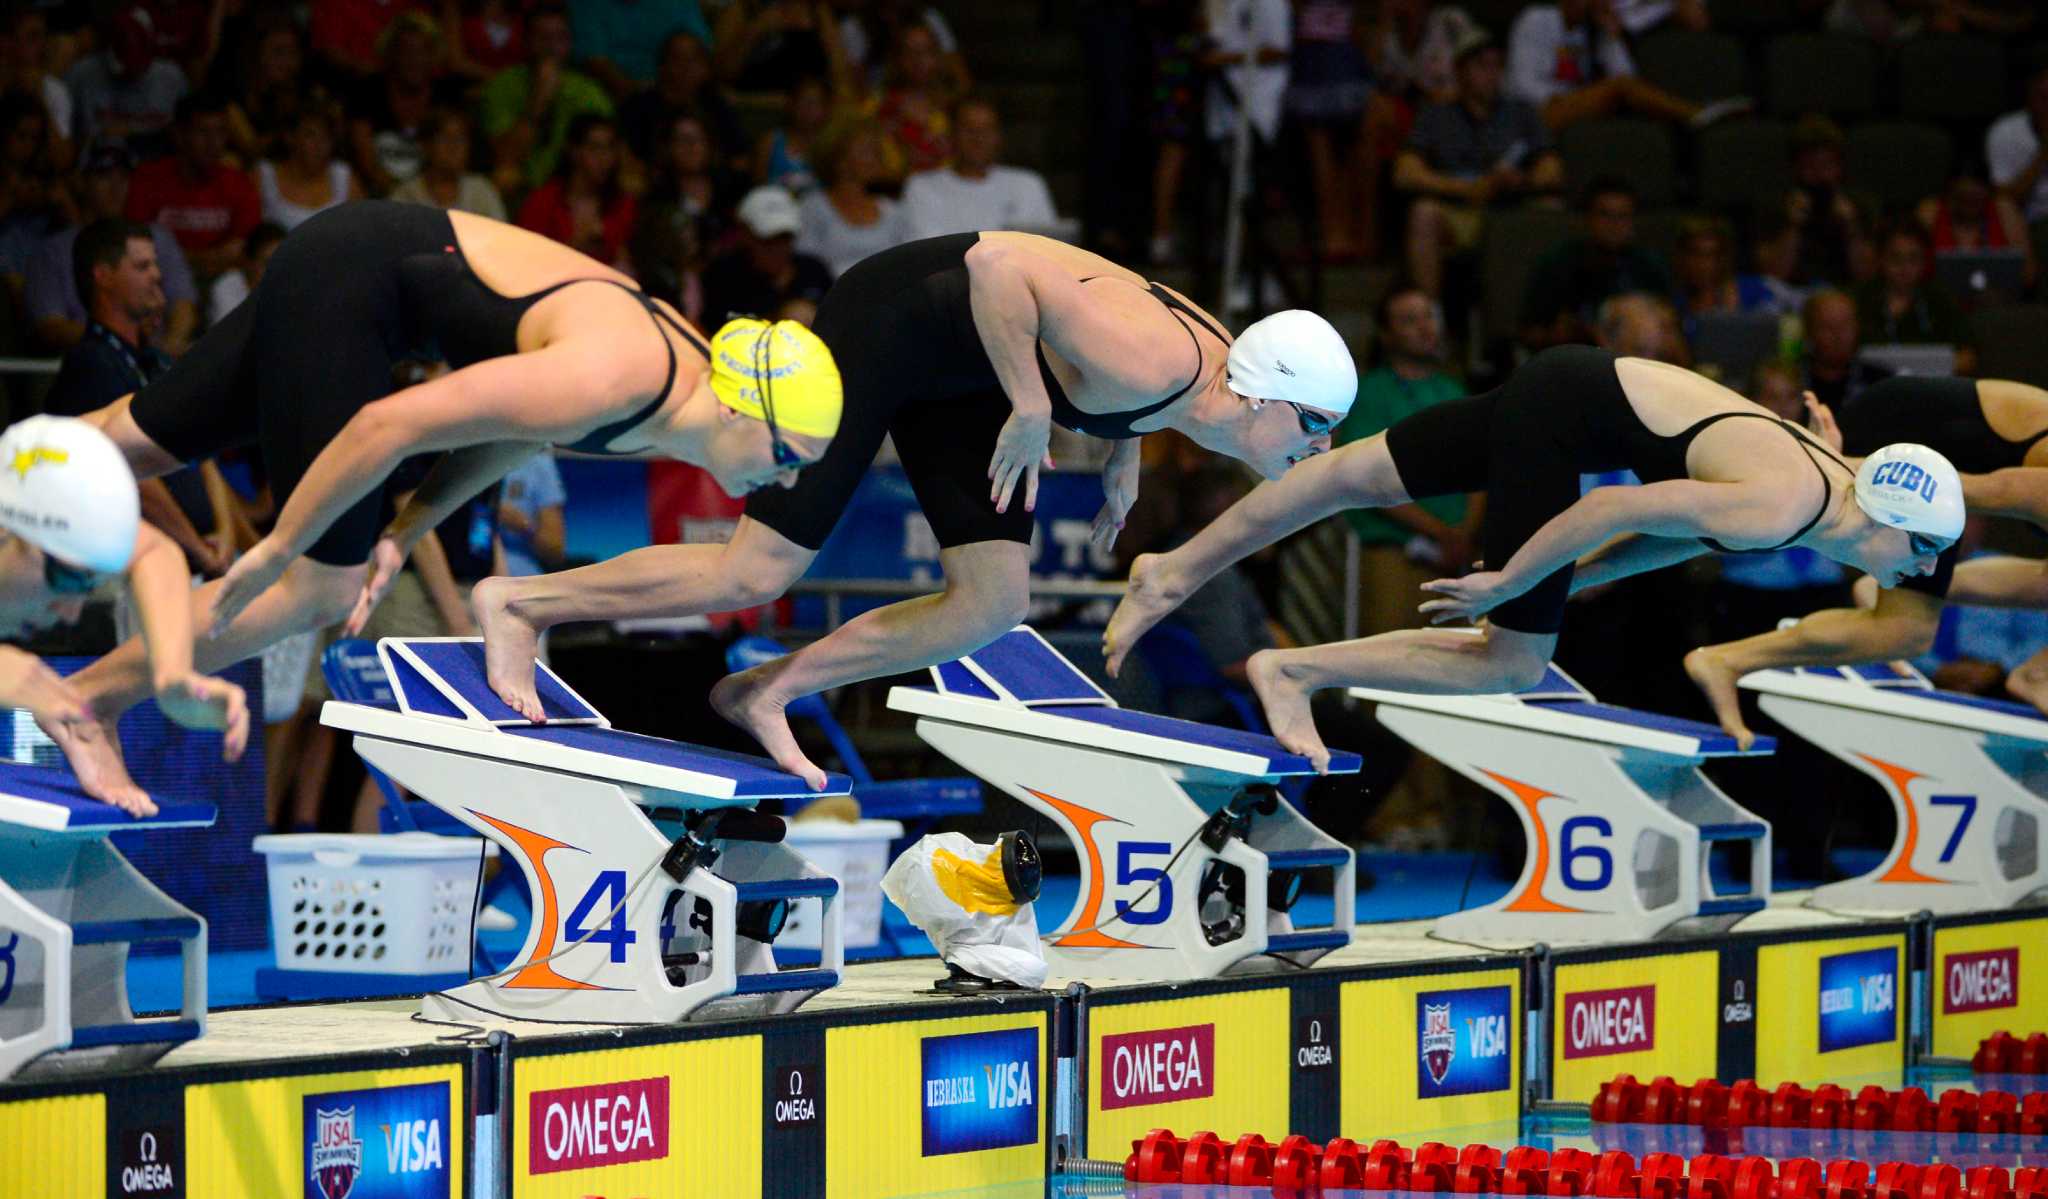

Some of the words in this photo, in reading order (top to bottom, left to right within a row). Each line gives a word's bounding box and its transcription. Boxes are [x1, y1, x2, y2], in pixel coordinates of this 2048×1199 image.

[1871, 461, 1938, 503] CUBU
[1559, 815, 1613, 891] 6
[1929, 794, 1977, 862] 7
[1114, 841, 1173, 925] 5
[564, 870, 636, 963] 4
[1859, 973, 1894, 1016] VISA
[1949, 958, 2012, 1007] OMEGA
[1466, 1015, 1507, 1058] VISA
[1571, 996, 1647, 1050] OMEGA
[1112, 1036, 1204, 1099] OMEGA
[1298, 1046, 1332, 1067] OMEGA
[926, 1076, 976, 1108] NEBRASKA
[983, 1060, 1032, 1110] VISA
[323, 1120, 352, 1147] USA
[543, 1090, 655, 1162] OMEGA
[775, 1098, 816, 1123] OMEGA
[381, 1118, 442, 1174] VISA
[122, 1163, 174, 1193] OMEGA
